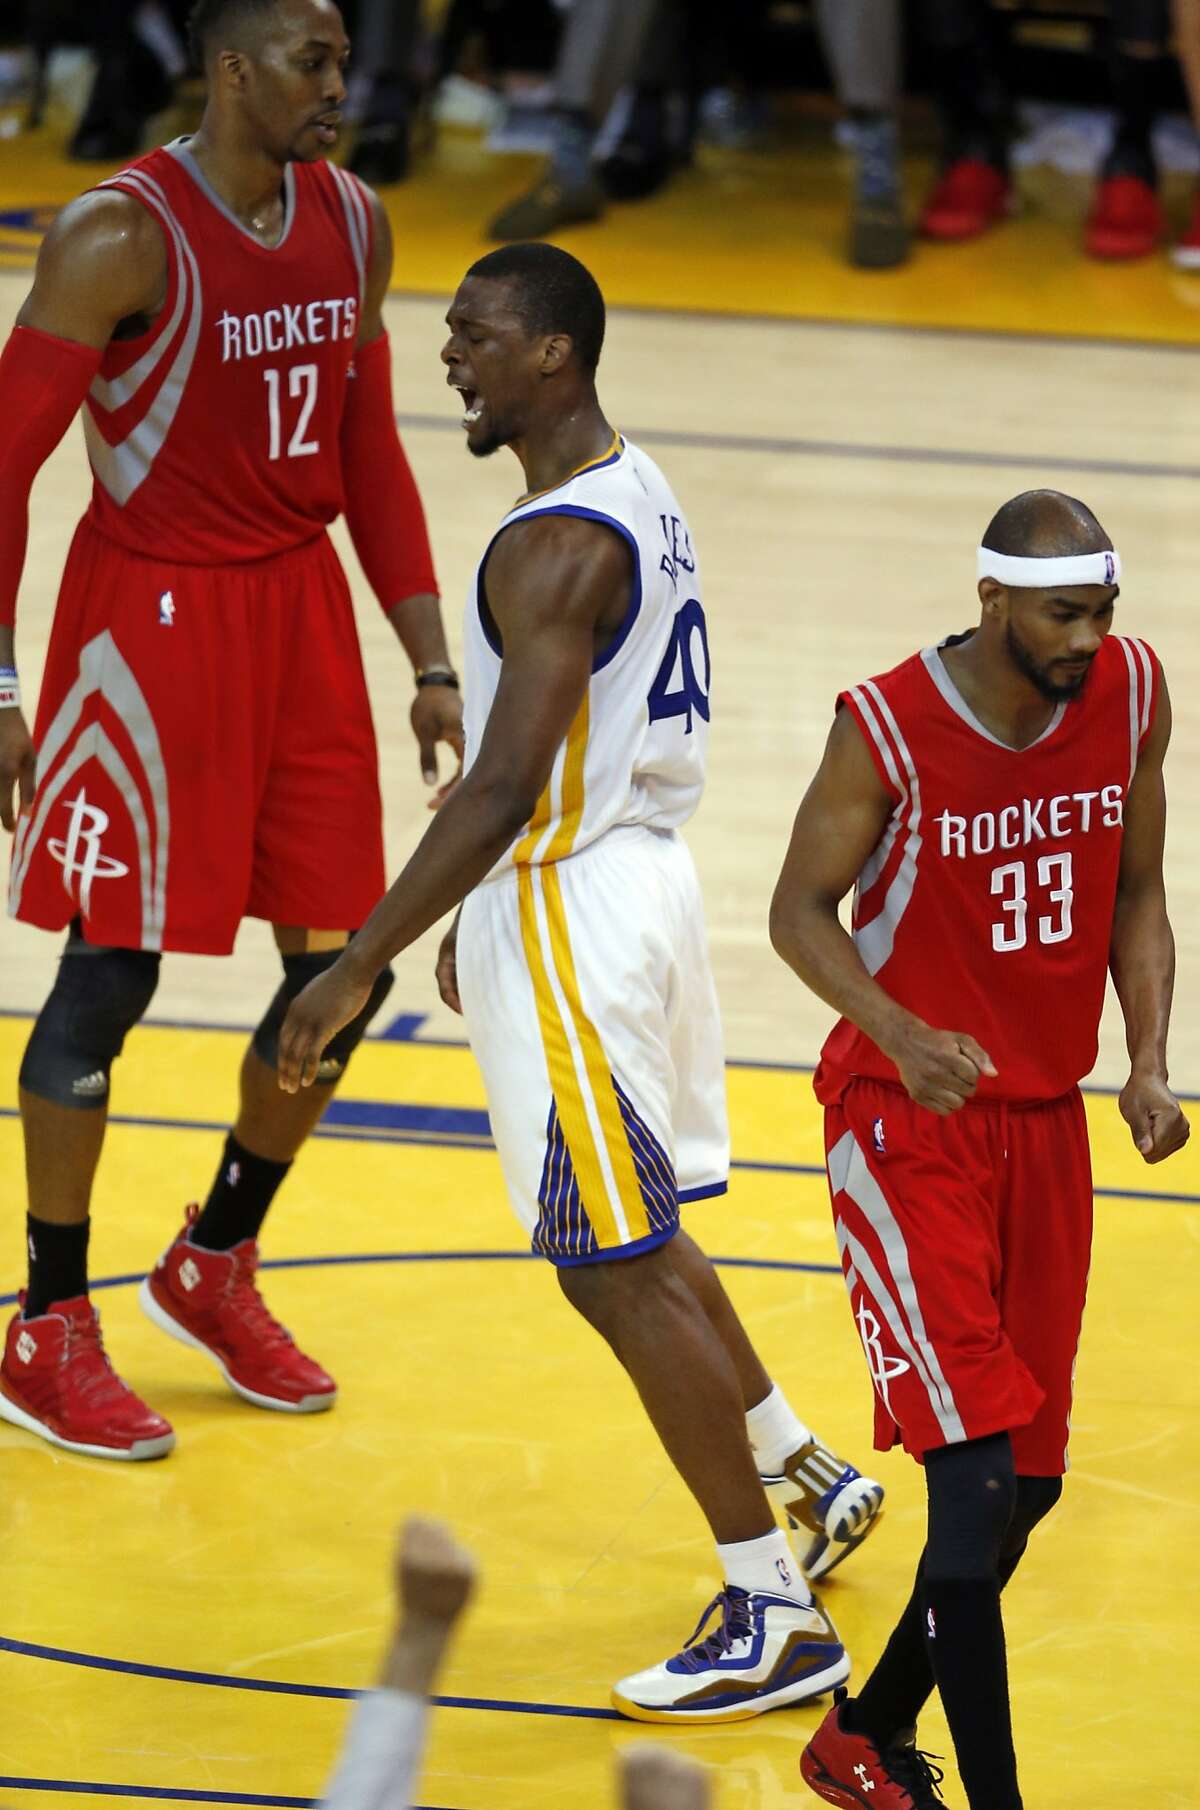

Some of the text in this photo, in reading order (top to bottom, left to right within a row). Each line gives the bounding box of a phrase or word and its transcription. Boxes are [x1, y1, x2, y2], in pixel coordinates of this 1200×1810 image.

[215, 297, 357, 362] ROCKETS
[264, 364, 319, 460] 12
[647, 599, 711, 735] 40
[933, 785, 1124, 859] ROCKETS
[990, 852, 1074, 952] 33
